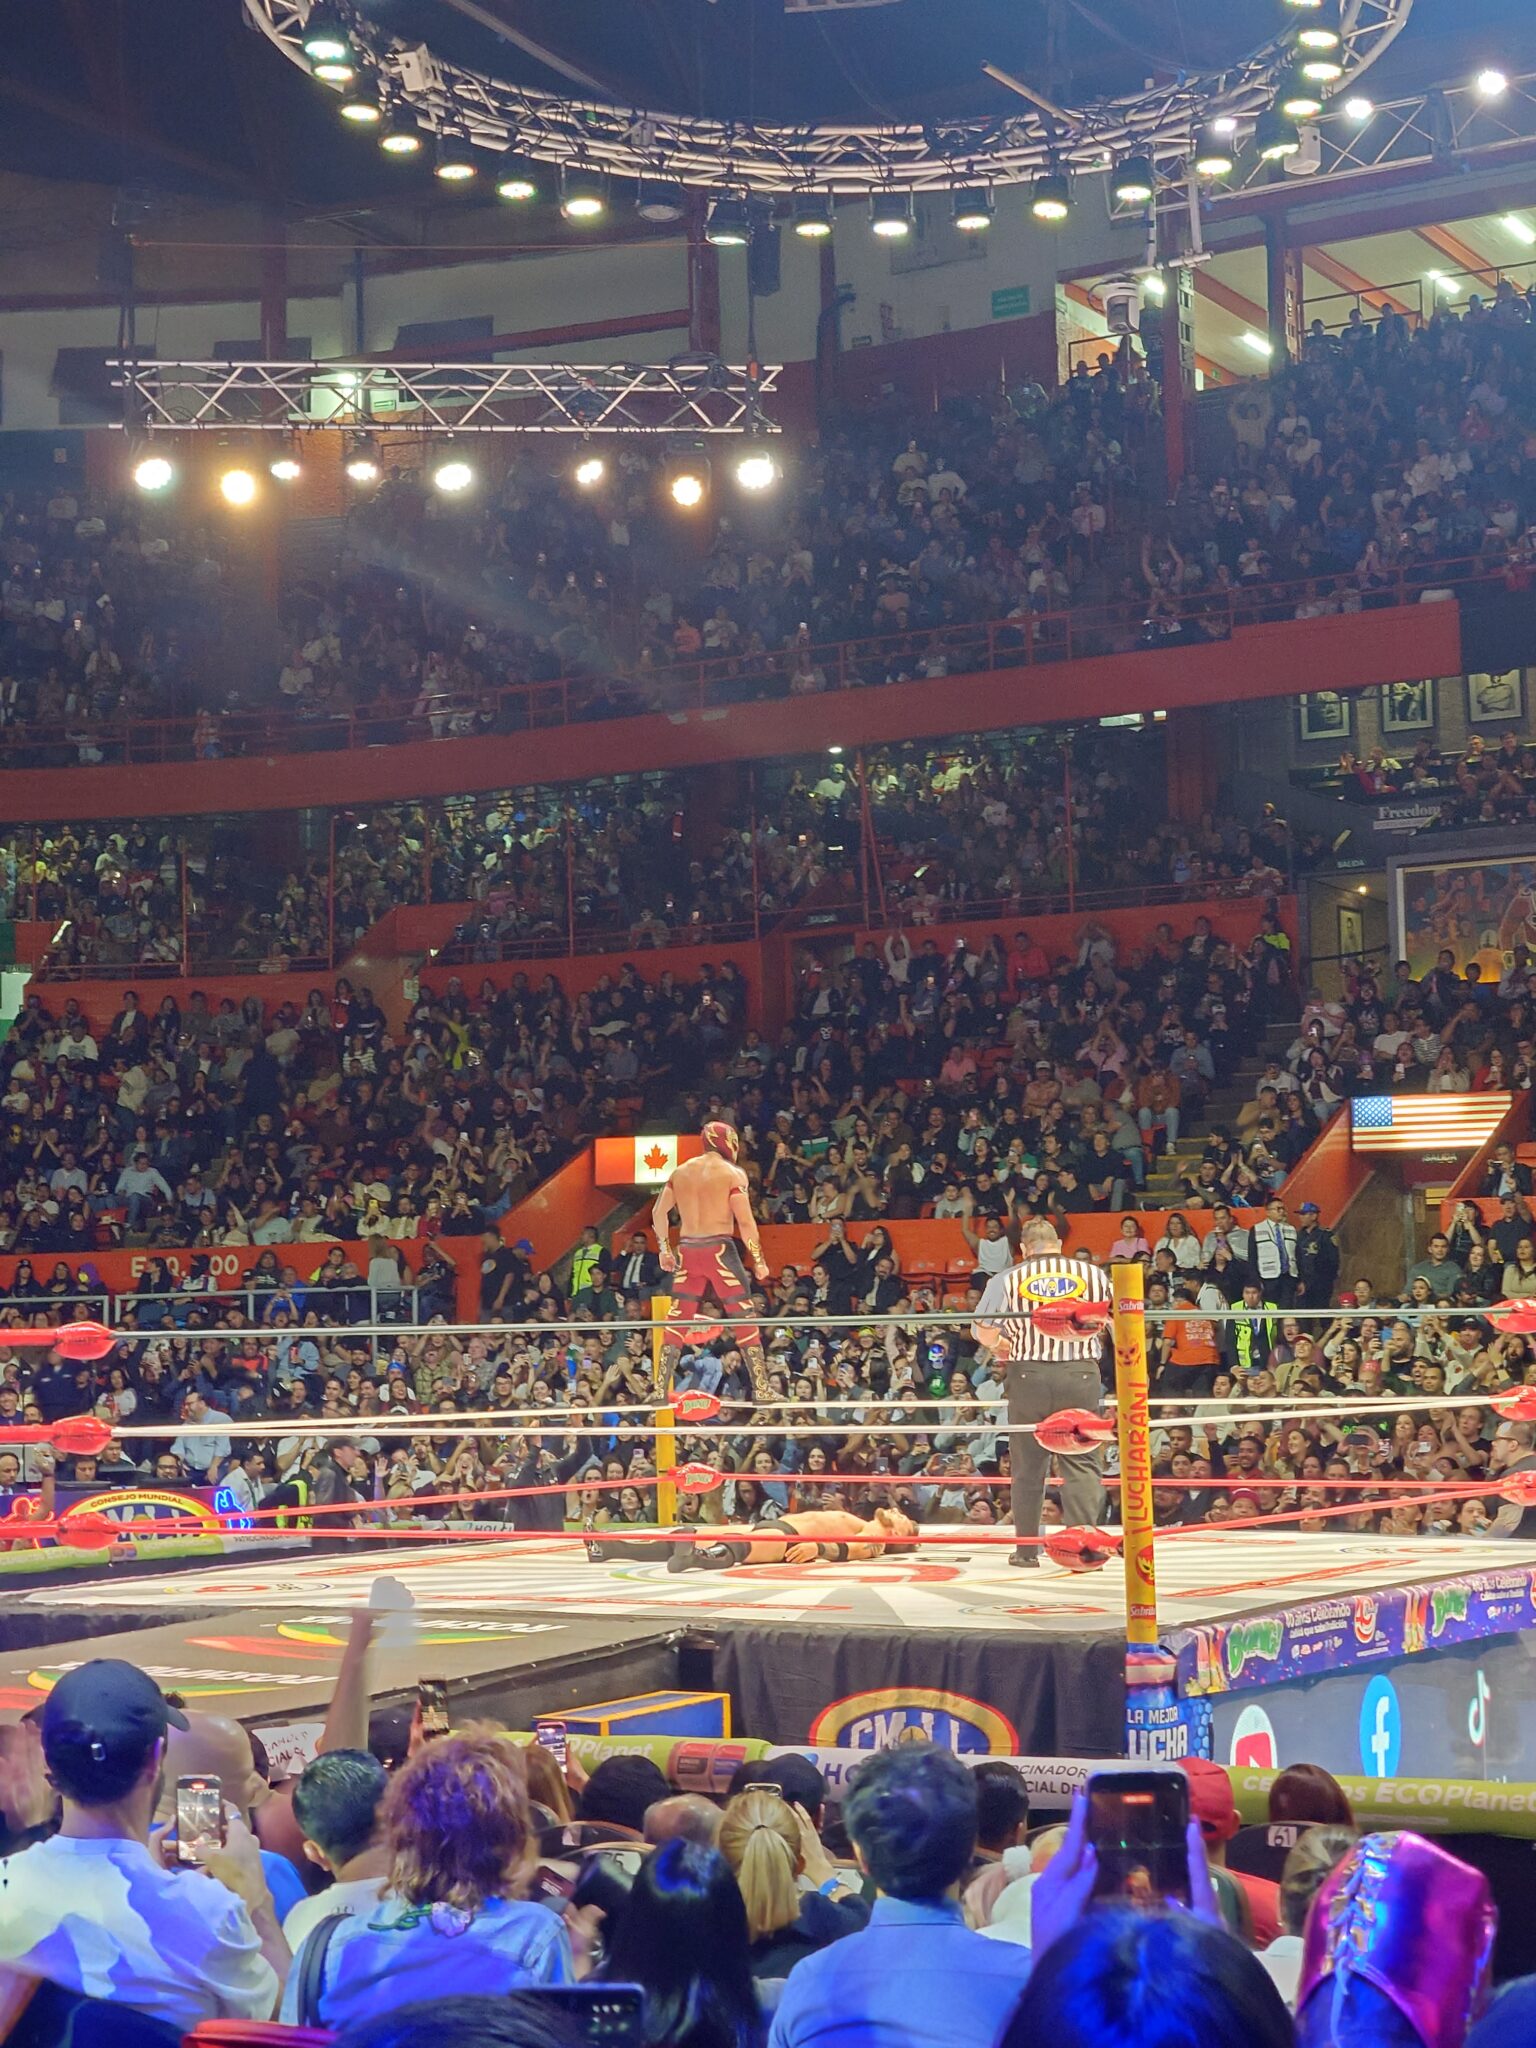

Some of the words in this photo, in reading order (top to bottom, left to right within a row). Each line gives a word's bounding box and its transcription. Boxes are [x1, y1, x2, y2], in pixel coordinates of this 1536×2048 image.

[90, 1494, 137, 1507] CONSEJO
[138, 1493, 184, 1505] MUNDIAL
[1127, 1709, 1144, 1724] LA
[1149, 1706, 1179, 1724] MEJOR
[1127, 1724, 1188, 1761] UCHA
[1025, 1781, 1057, 1794] CIAL
[1274, 1827, 1290, 1847] 61
